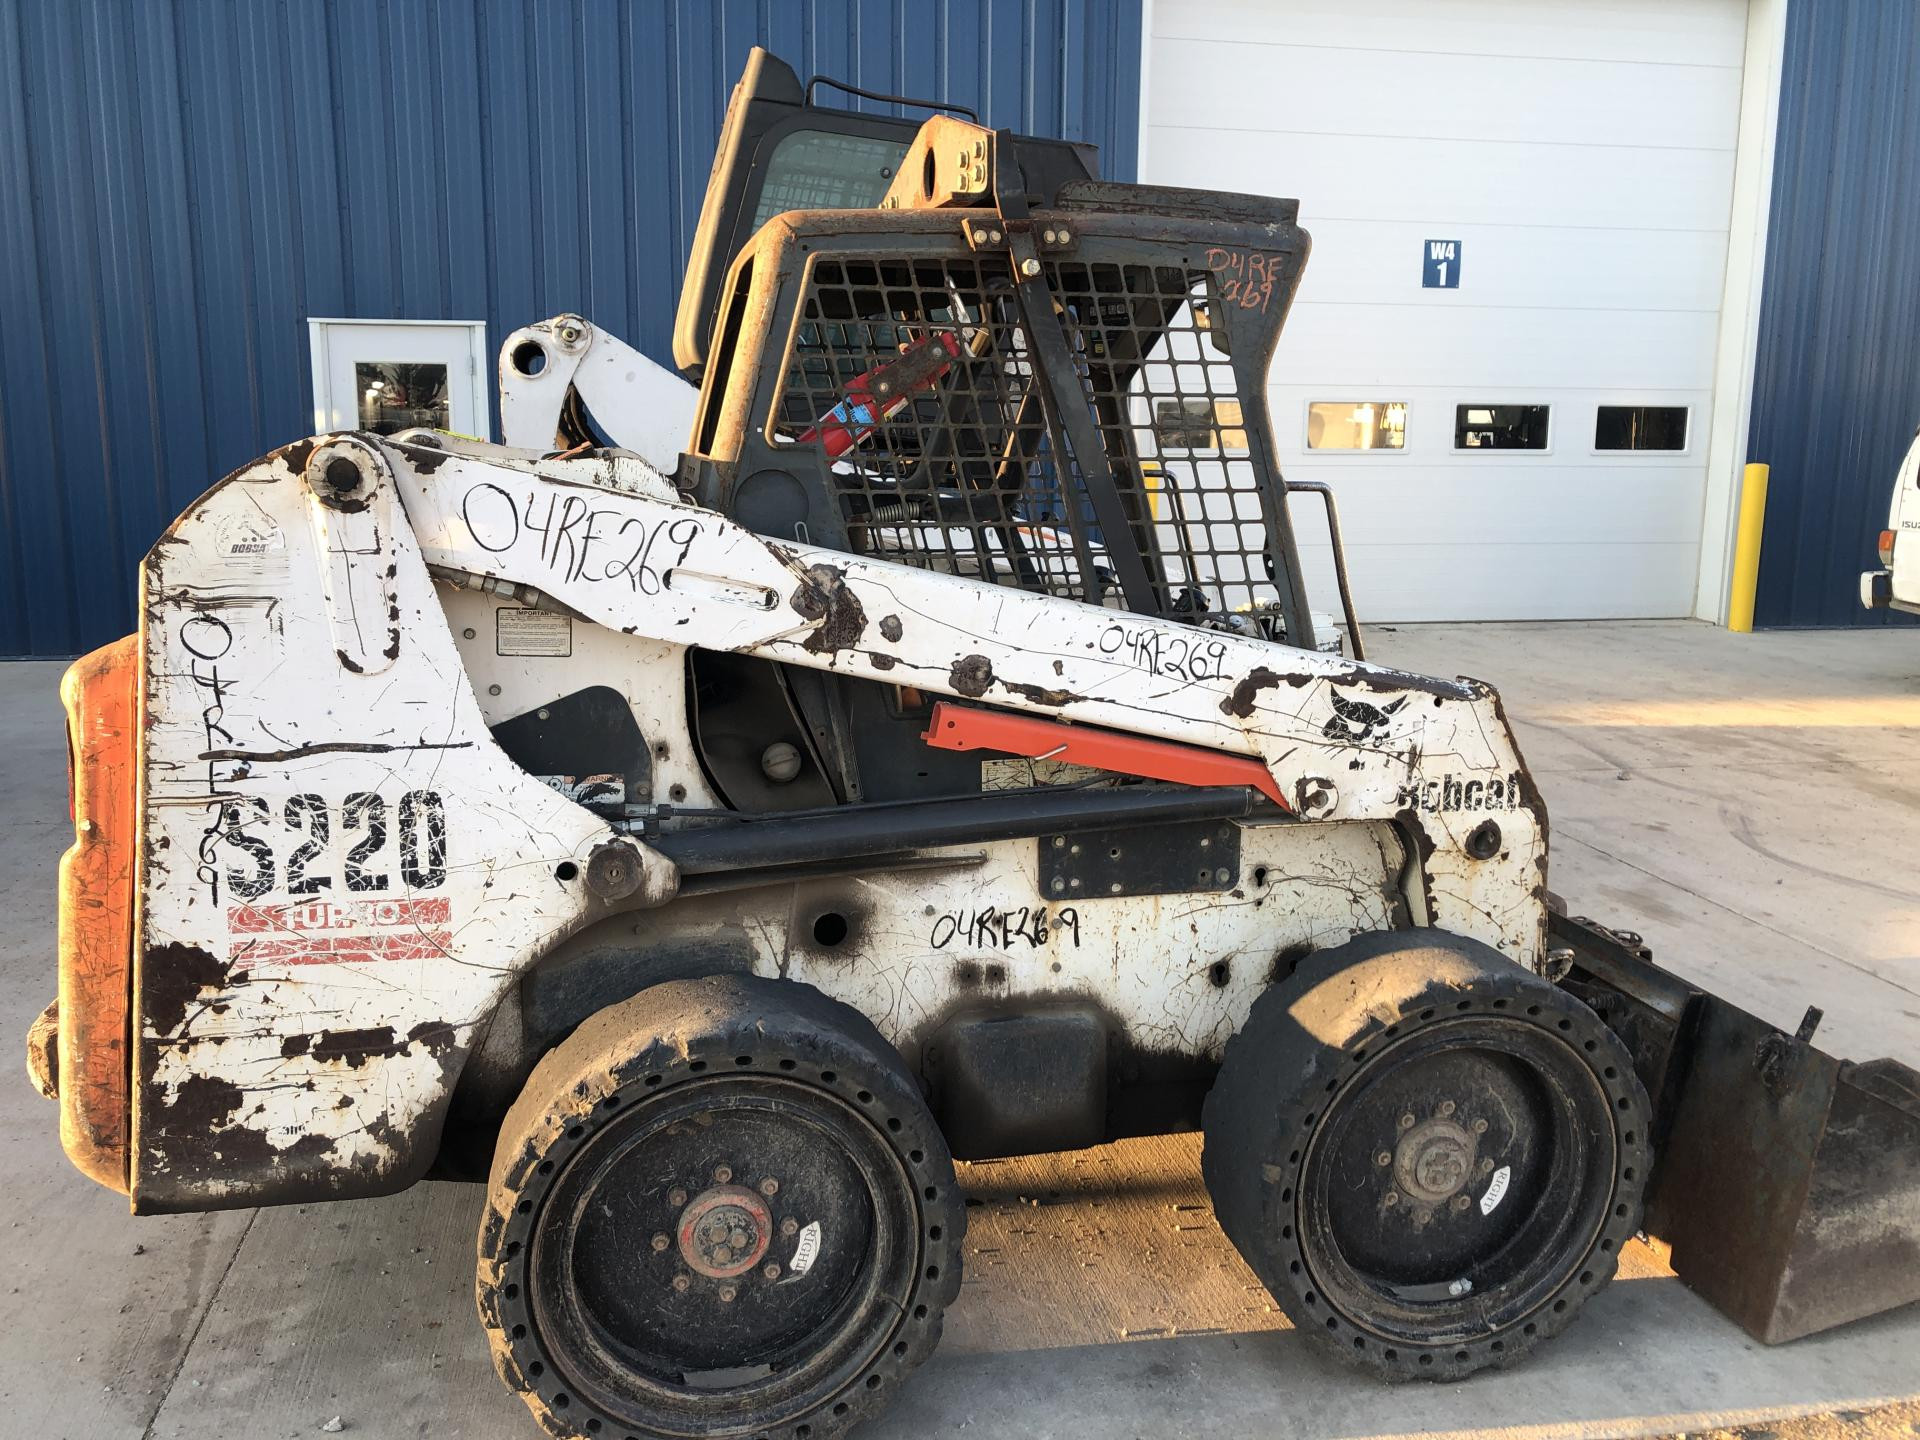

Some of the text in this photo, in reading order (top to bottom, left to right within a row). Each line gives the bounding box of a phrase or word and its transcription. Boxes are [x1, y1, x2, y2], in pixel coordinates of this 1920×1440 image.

[1431, 242, 1455, 260] W4
[1437, 261, 1447, 286] 1
[463, 483, 704, 596] 04RE269
[1099, 625, 1228, 681] 04RE269
[225, 789, 447, 898] S220
[931, 905, 1080, 950] 04RE269
[1483, 1171, 1508, 1211] RIGHT
[795, 1225, 818, 1271] RIGHT
